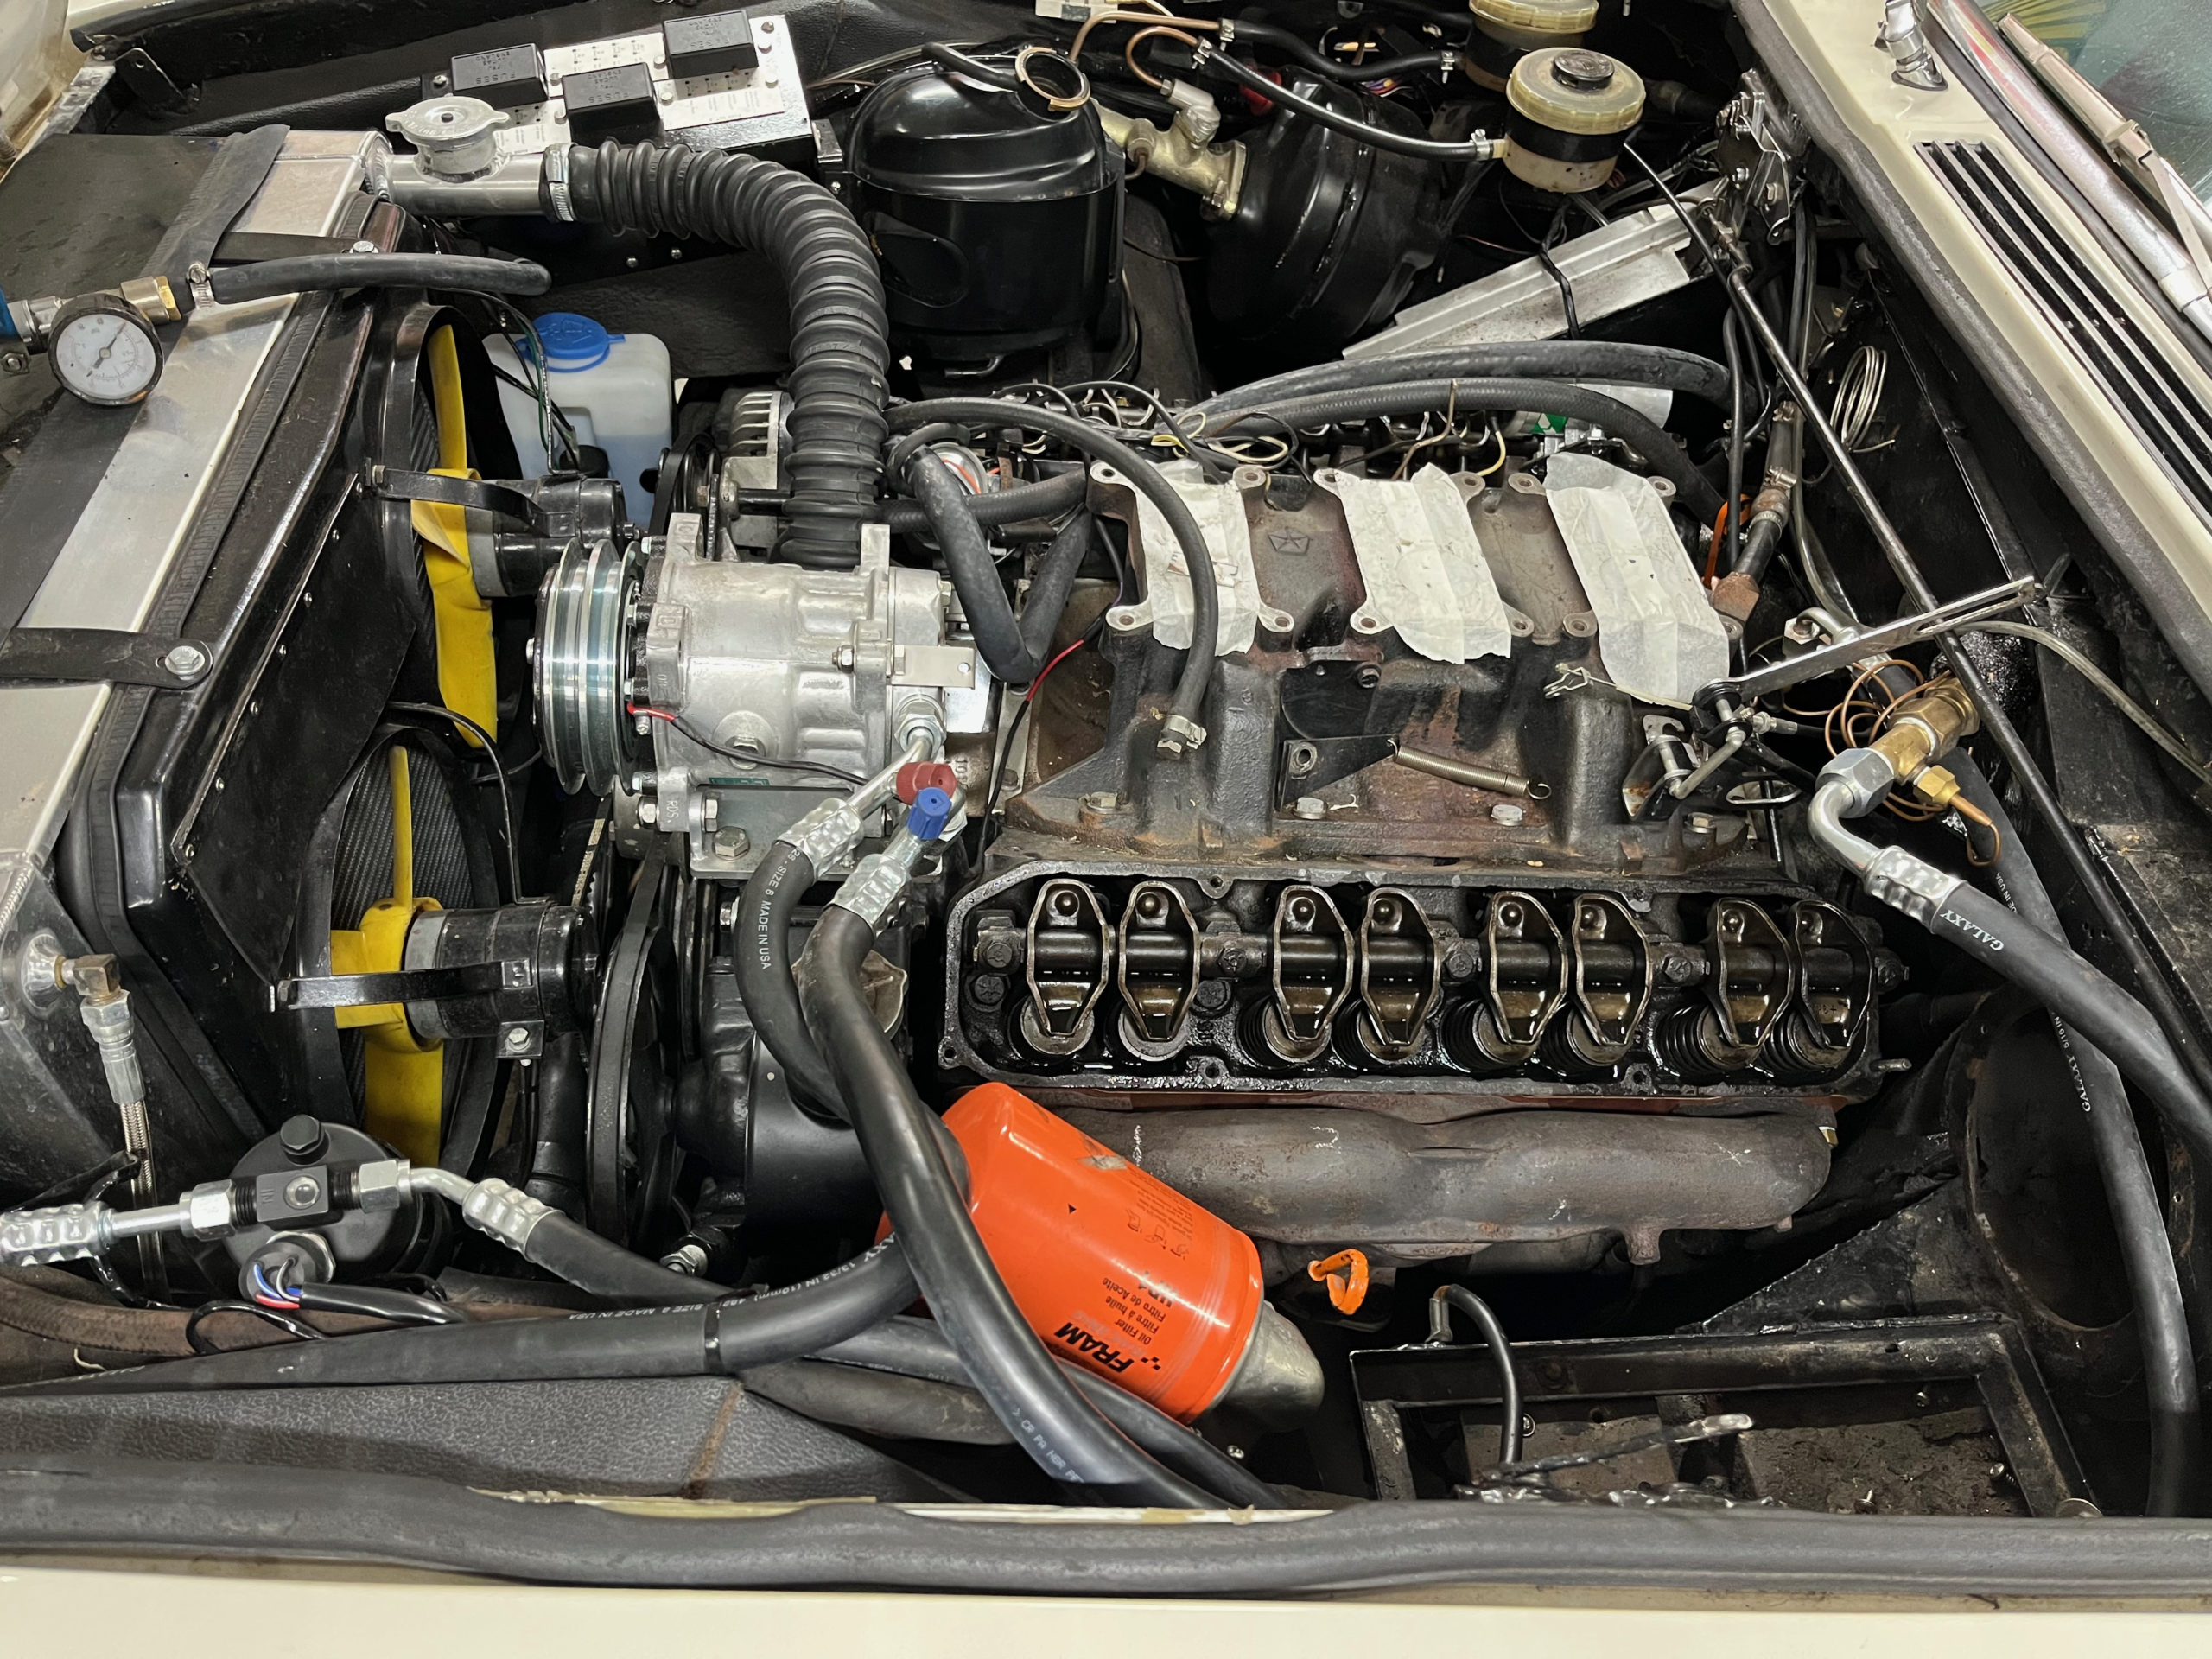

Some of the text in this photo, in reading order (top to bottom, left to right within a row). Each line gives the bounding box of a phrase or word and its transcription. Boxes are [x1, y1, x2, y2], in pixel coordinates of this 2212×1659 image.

[476, 51, 511, 61] ENGLAND
[483, 57, 506, 67] LUCAS
[476, 71, 516, 85] FUSES
[588, 69, 621, 79] ENGLAND
[588, 91, 630, 104] FUSES
[768, 865, 787, 888] SIZE
[1995, 872, 2006, 891] USA
[2003, 891, 2012, 902] IN
[758, 900, 772, 931] MADE
[1939, 909, 2005, 951] GALAXY
[758, 934, 768, 944] IN
[759, 947, 772, 969] USA
[2054, 1016, 2062, 1027] IN
[259, 1188, 275, 1205] IN
[823, 1262, 855, 1281] 13/32
[805, 1277, 820, 1288] IN
[753, 1283, 801, 1301] (10mm)
[1102, 1277, 1166, 1322] Filtro de Aceite
[614, 1307, 656, 1318] MADE
[673, 1303, 703, 1313] SIZE
[1105, 1296, 1160, 1334] Filtre à huile
[1115, 1319, 1152, 1345] Oil Filter
[1054, 1322, 1135, 1373] FRAM
